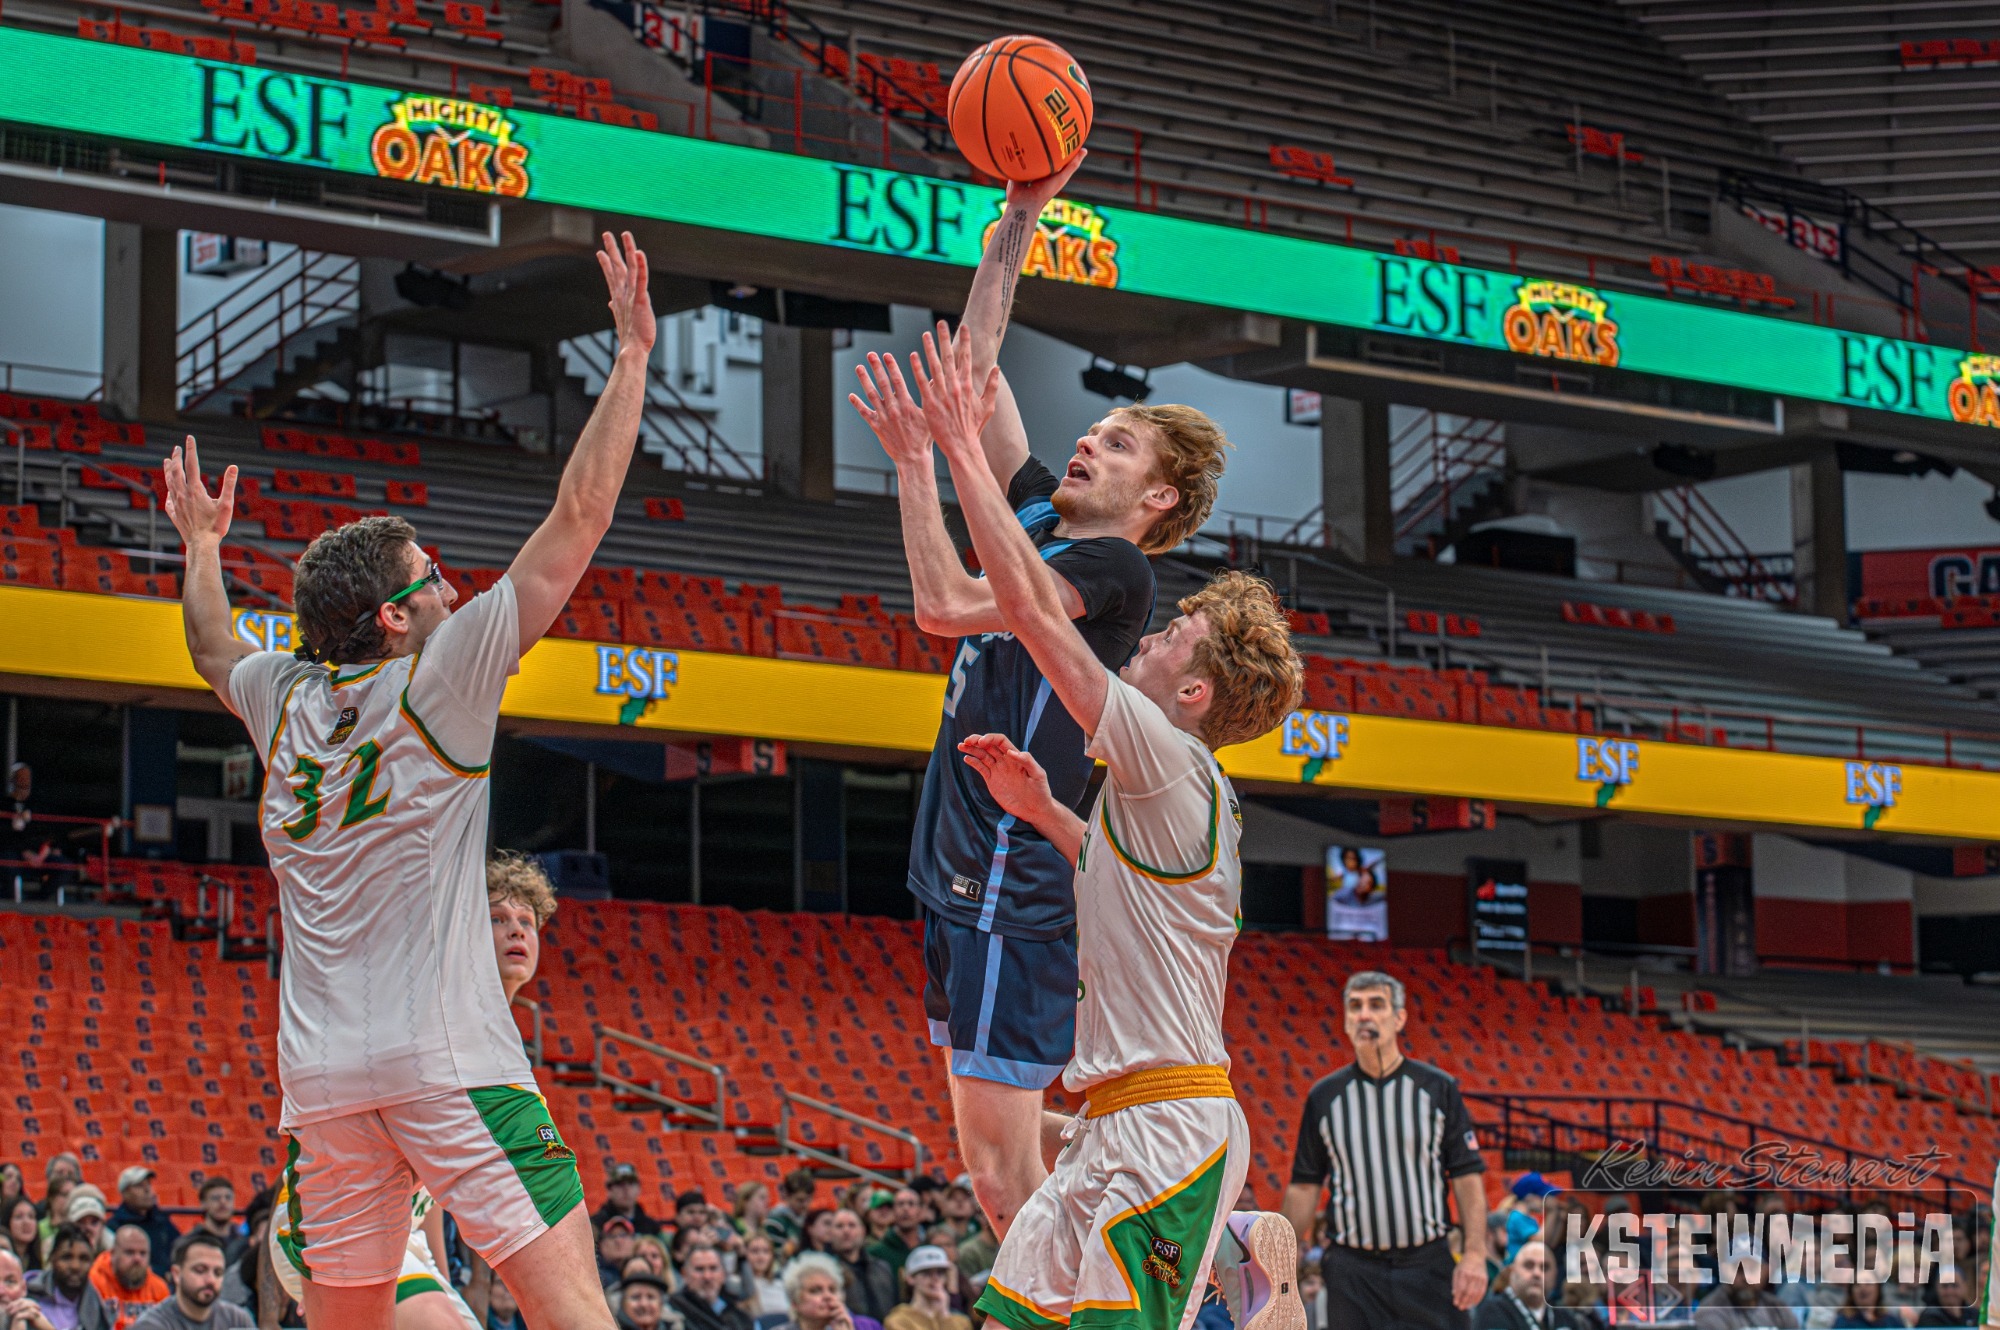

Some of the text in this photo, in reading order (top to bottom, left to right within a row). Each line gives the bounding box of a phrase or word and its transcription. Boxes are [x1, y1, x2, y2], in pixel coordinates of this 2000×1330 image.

[190, 62, 352, 162] ESF
[406, 98, 501, 137] MIGHTY
[1044, 87, 1082, 157] ELITE
[371, 123, 529, 198] OAKS
[829, 166, 966, 258] ESF
[983, 222, 1119, 289] AKS
[1374, 256, 1490, 341] ESF
[1504, 303, 1619, 367] OAKS
[1839, 335, 1936, 409] ESF
[236, 611, 292, 653] SF
[595, 645, 678, 700] ESF
[1280, 710, 1350, 760] ESF
[1576, 737, 1639, 785] ESF
[282, 737, 392, 842] 32
[1844, 762, 1902, 807] ESF
[1154, 1240, 1178, 1259] ESF
